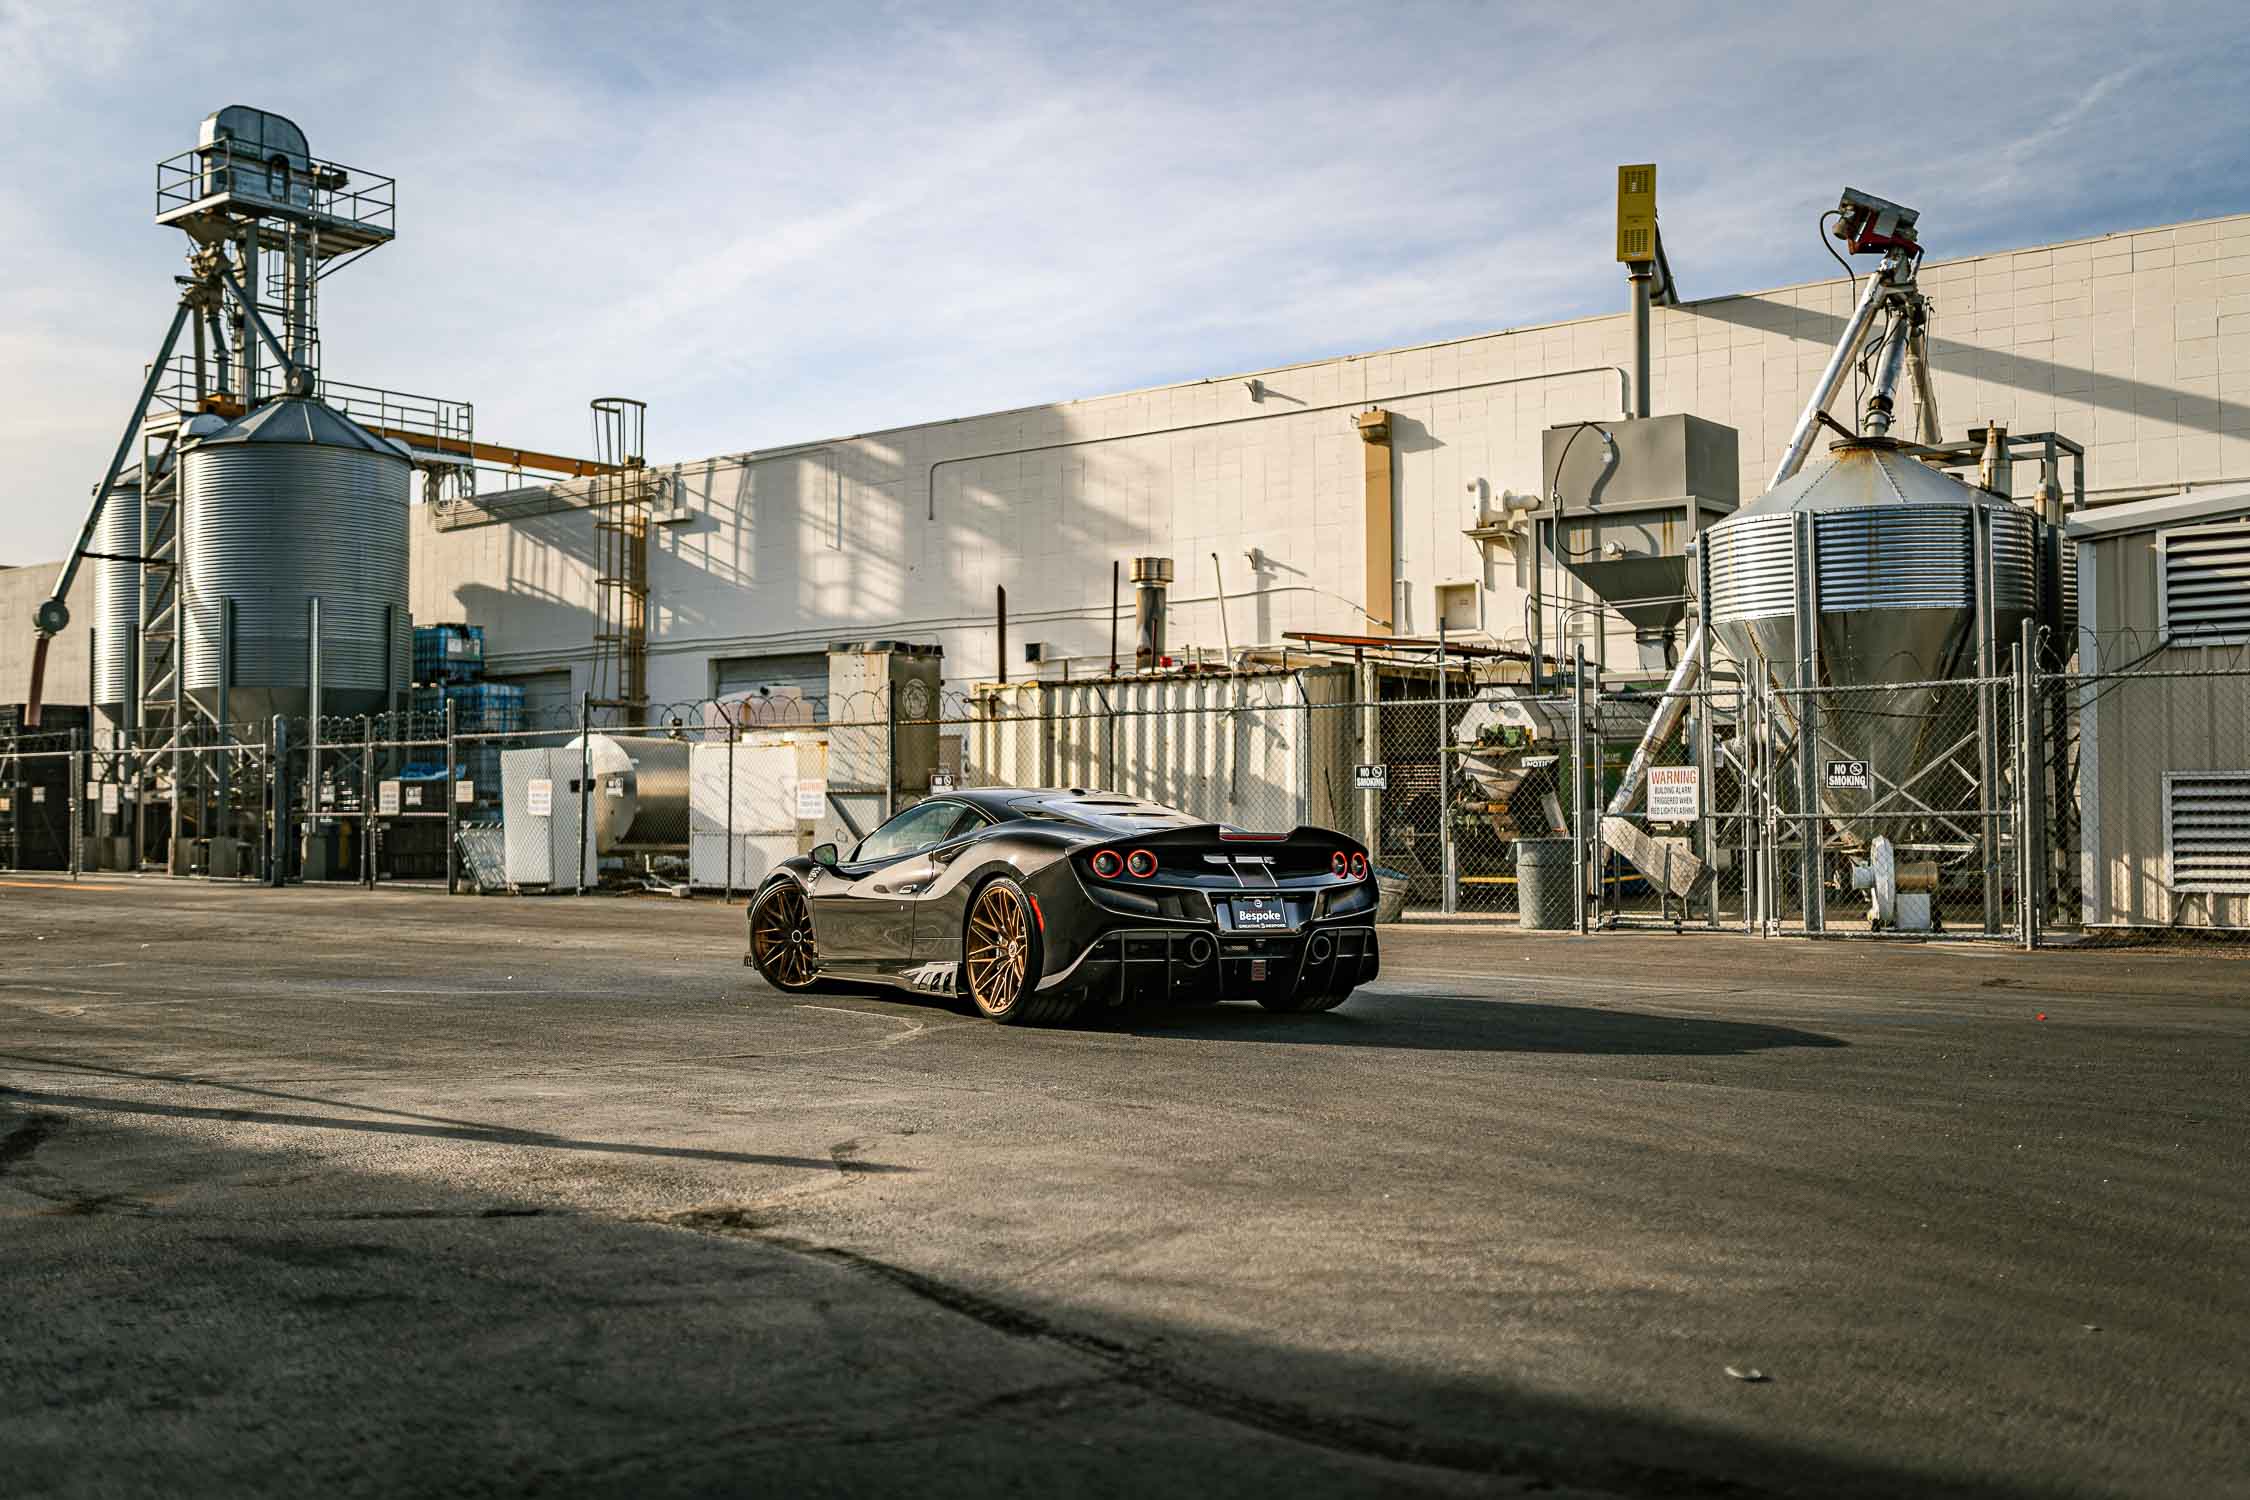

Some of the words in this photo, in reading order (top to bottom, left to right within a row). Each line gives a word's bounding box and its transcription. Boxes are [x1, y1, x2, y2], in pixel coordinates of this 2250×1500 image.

[1360, 767, 1369, 777] NO
[1834, 763, 1846, 775] NO
[1356, 776, 1385, 787] SMOKING
[1651, 769, 1697, 785] WARNING
[1828, 775, 1866, 786] SMOKING
[1654, 785, 1675, 795] BUILDING
[1675, 785, 1692, 794] ALARM
[1654, 796, 1679, 805] TRIGGERED
[1679, 796, 1693, 805] WHEN
[1239, 910, 1281, 923] Bespoke
